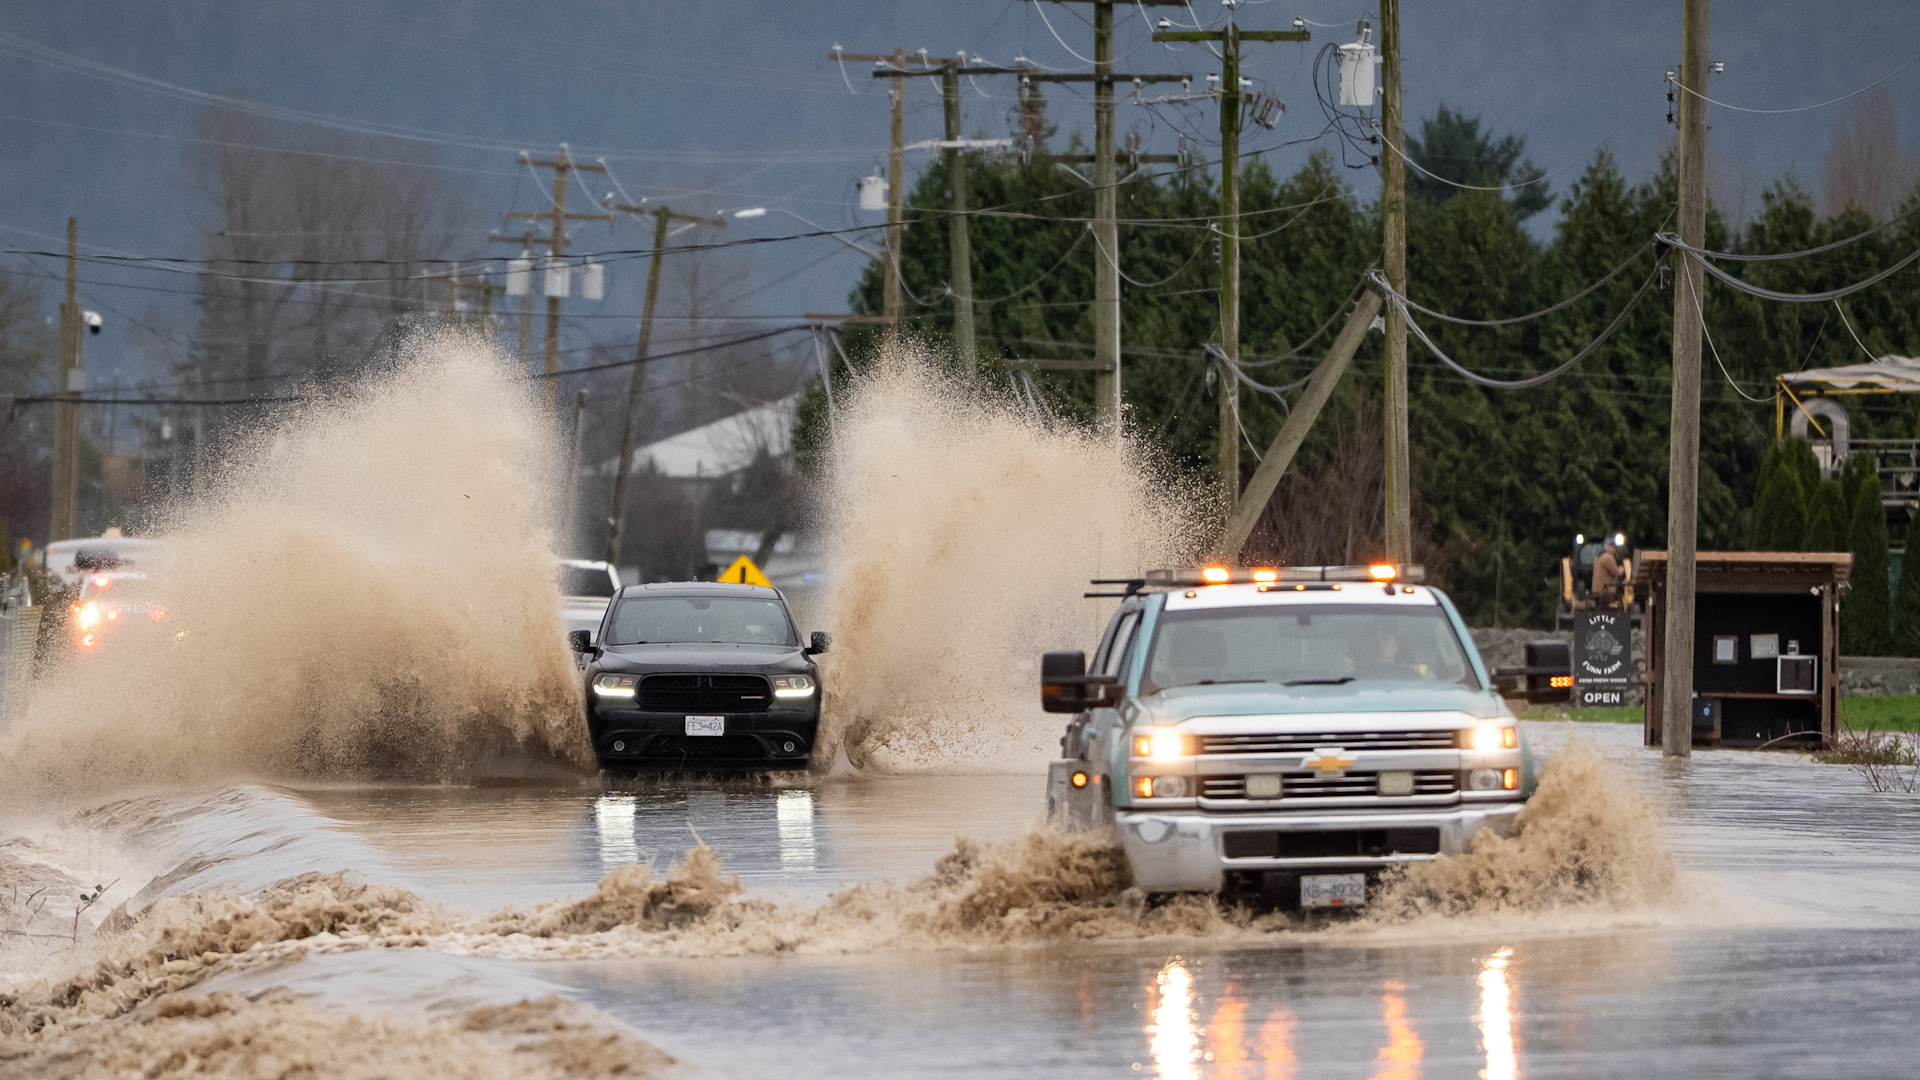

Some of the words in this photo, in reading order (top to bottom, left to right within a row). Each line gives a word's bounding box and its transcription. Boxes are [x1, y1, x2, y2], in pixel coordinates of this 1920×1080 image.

[1589, 615, 1616, 625] LITTLE
[1582, 660, 1602, 675] FUNN
[1603, 660, 1622, 675] FARM
[1584, 692, 1620, 703] OPEN
